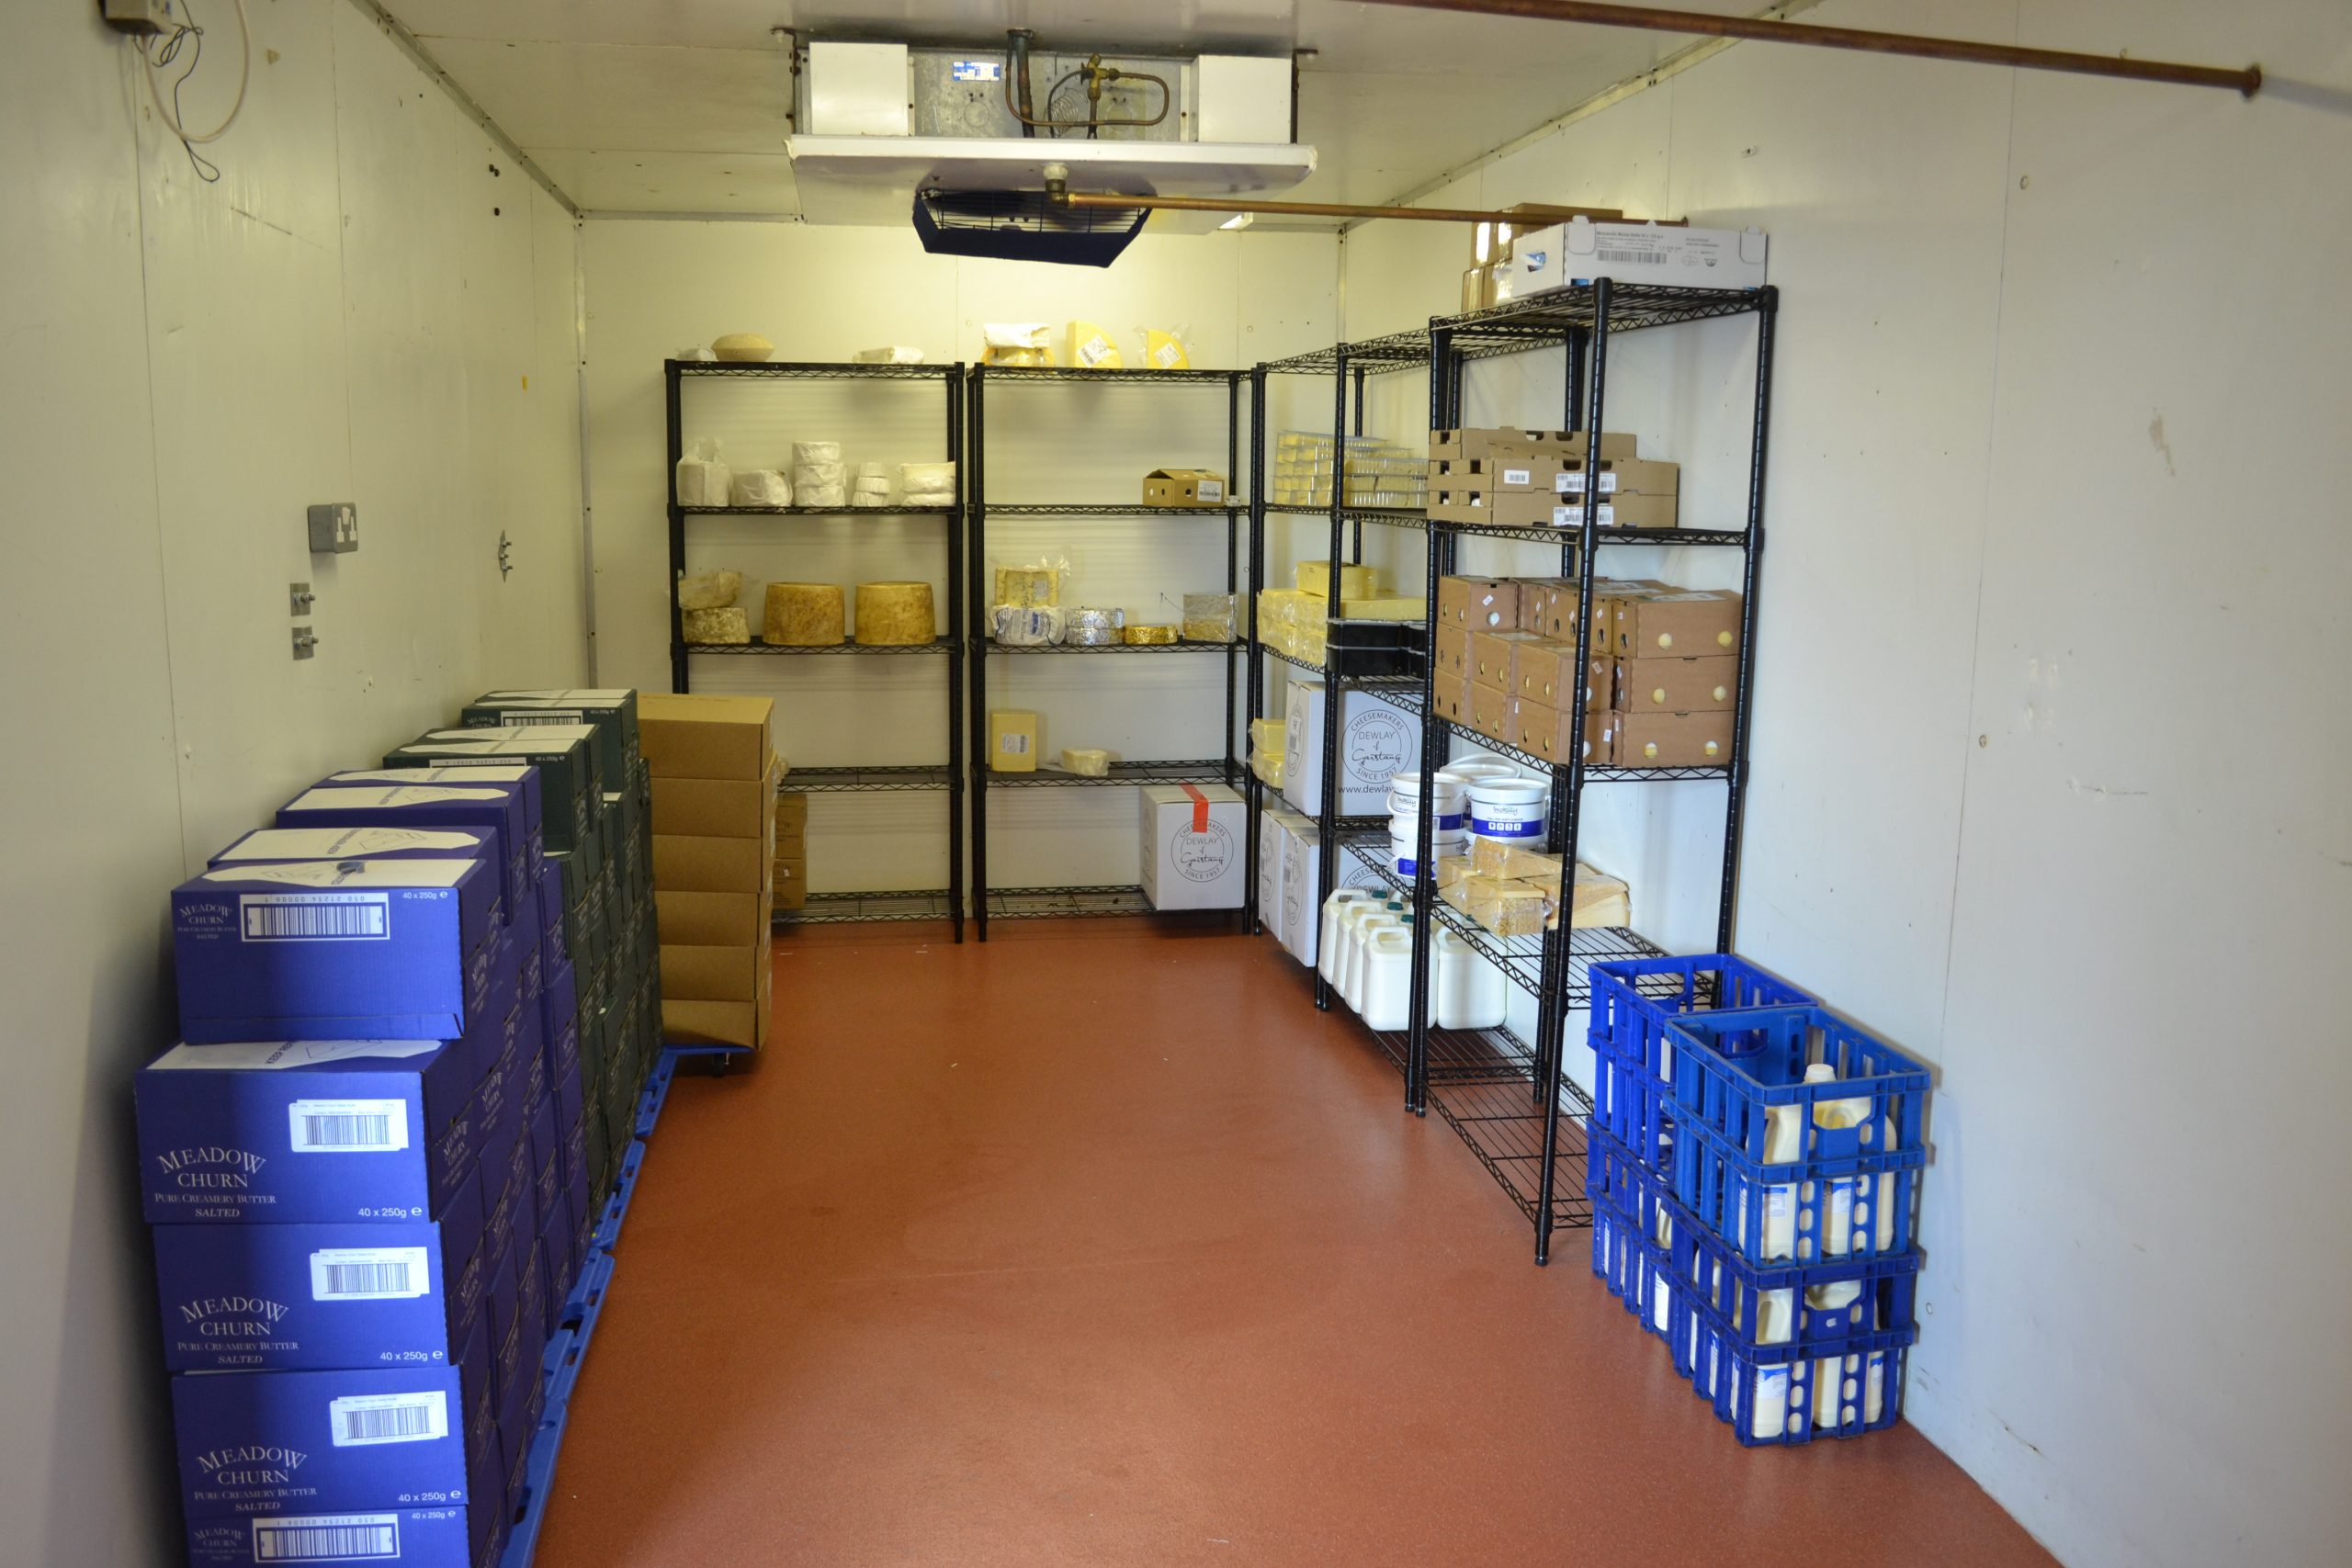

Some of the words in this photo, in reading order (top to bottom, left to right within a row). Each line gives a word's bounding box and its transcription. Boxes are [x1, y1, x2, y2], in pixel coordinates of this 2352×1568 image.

[1351, 712, 1405, 731] CHEESEMAKERS
[1359, 731, 1396, 739] DEWLAY
[1355, 767, 1378, 781] SINCE
[1186, 837, 1218, 845] DEWLAY
[179, 904, 233, 917] MEADOW
[188, 916, 224, 924] CHURN
[156, 1146, 266, 1174] MEADOW
[177, 1173, 249, 1188] CHURN
[154, 1193, 180, 1203] PURE
[182, 1194, 235, 1204] CREAMERY
[237, 1194, 277, 1204] BUTTER
[195, 1208, 241, 1218] SALTED
[357, 1208, 371, 1217] 40
[381, 1207, 407, 1219] 250g
[178, 1296, 289, 1323] MEADOW
[200, 1322, 271, 1336] CHURN
[177, 1342, 203, 1351] PURE
[205, 1342, 258, 1351] CREAMERY
[260, 1341, 300, 1351] BUTTER
[218, 1355, 263, 1364] SALTED
[379, 1351, 393, 1360] 40
[403, 1351, 428, 1362] 250g
[197, 1446, 308, 1473] MEADOW
[217, 1469, 289, 1485] CHURN
[194, 1490, 220, 1500] PURE
[221, 1489, 277, 1500] CREAMERY
[277, 1487, 318, 1497] BUTTER
[398, 1494, 411, 1502] 40
[421, 1491, 447, 1502] 250g
[234, 1501, 280, 1512] SALTED
[427, 1511, 446, 1520] 250g
